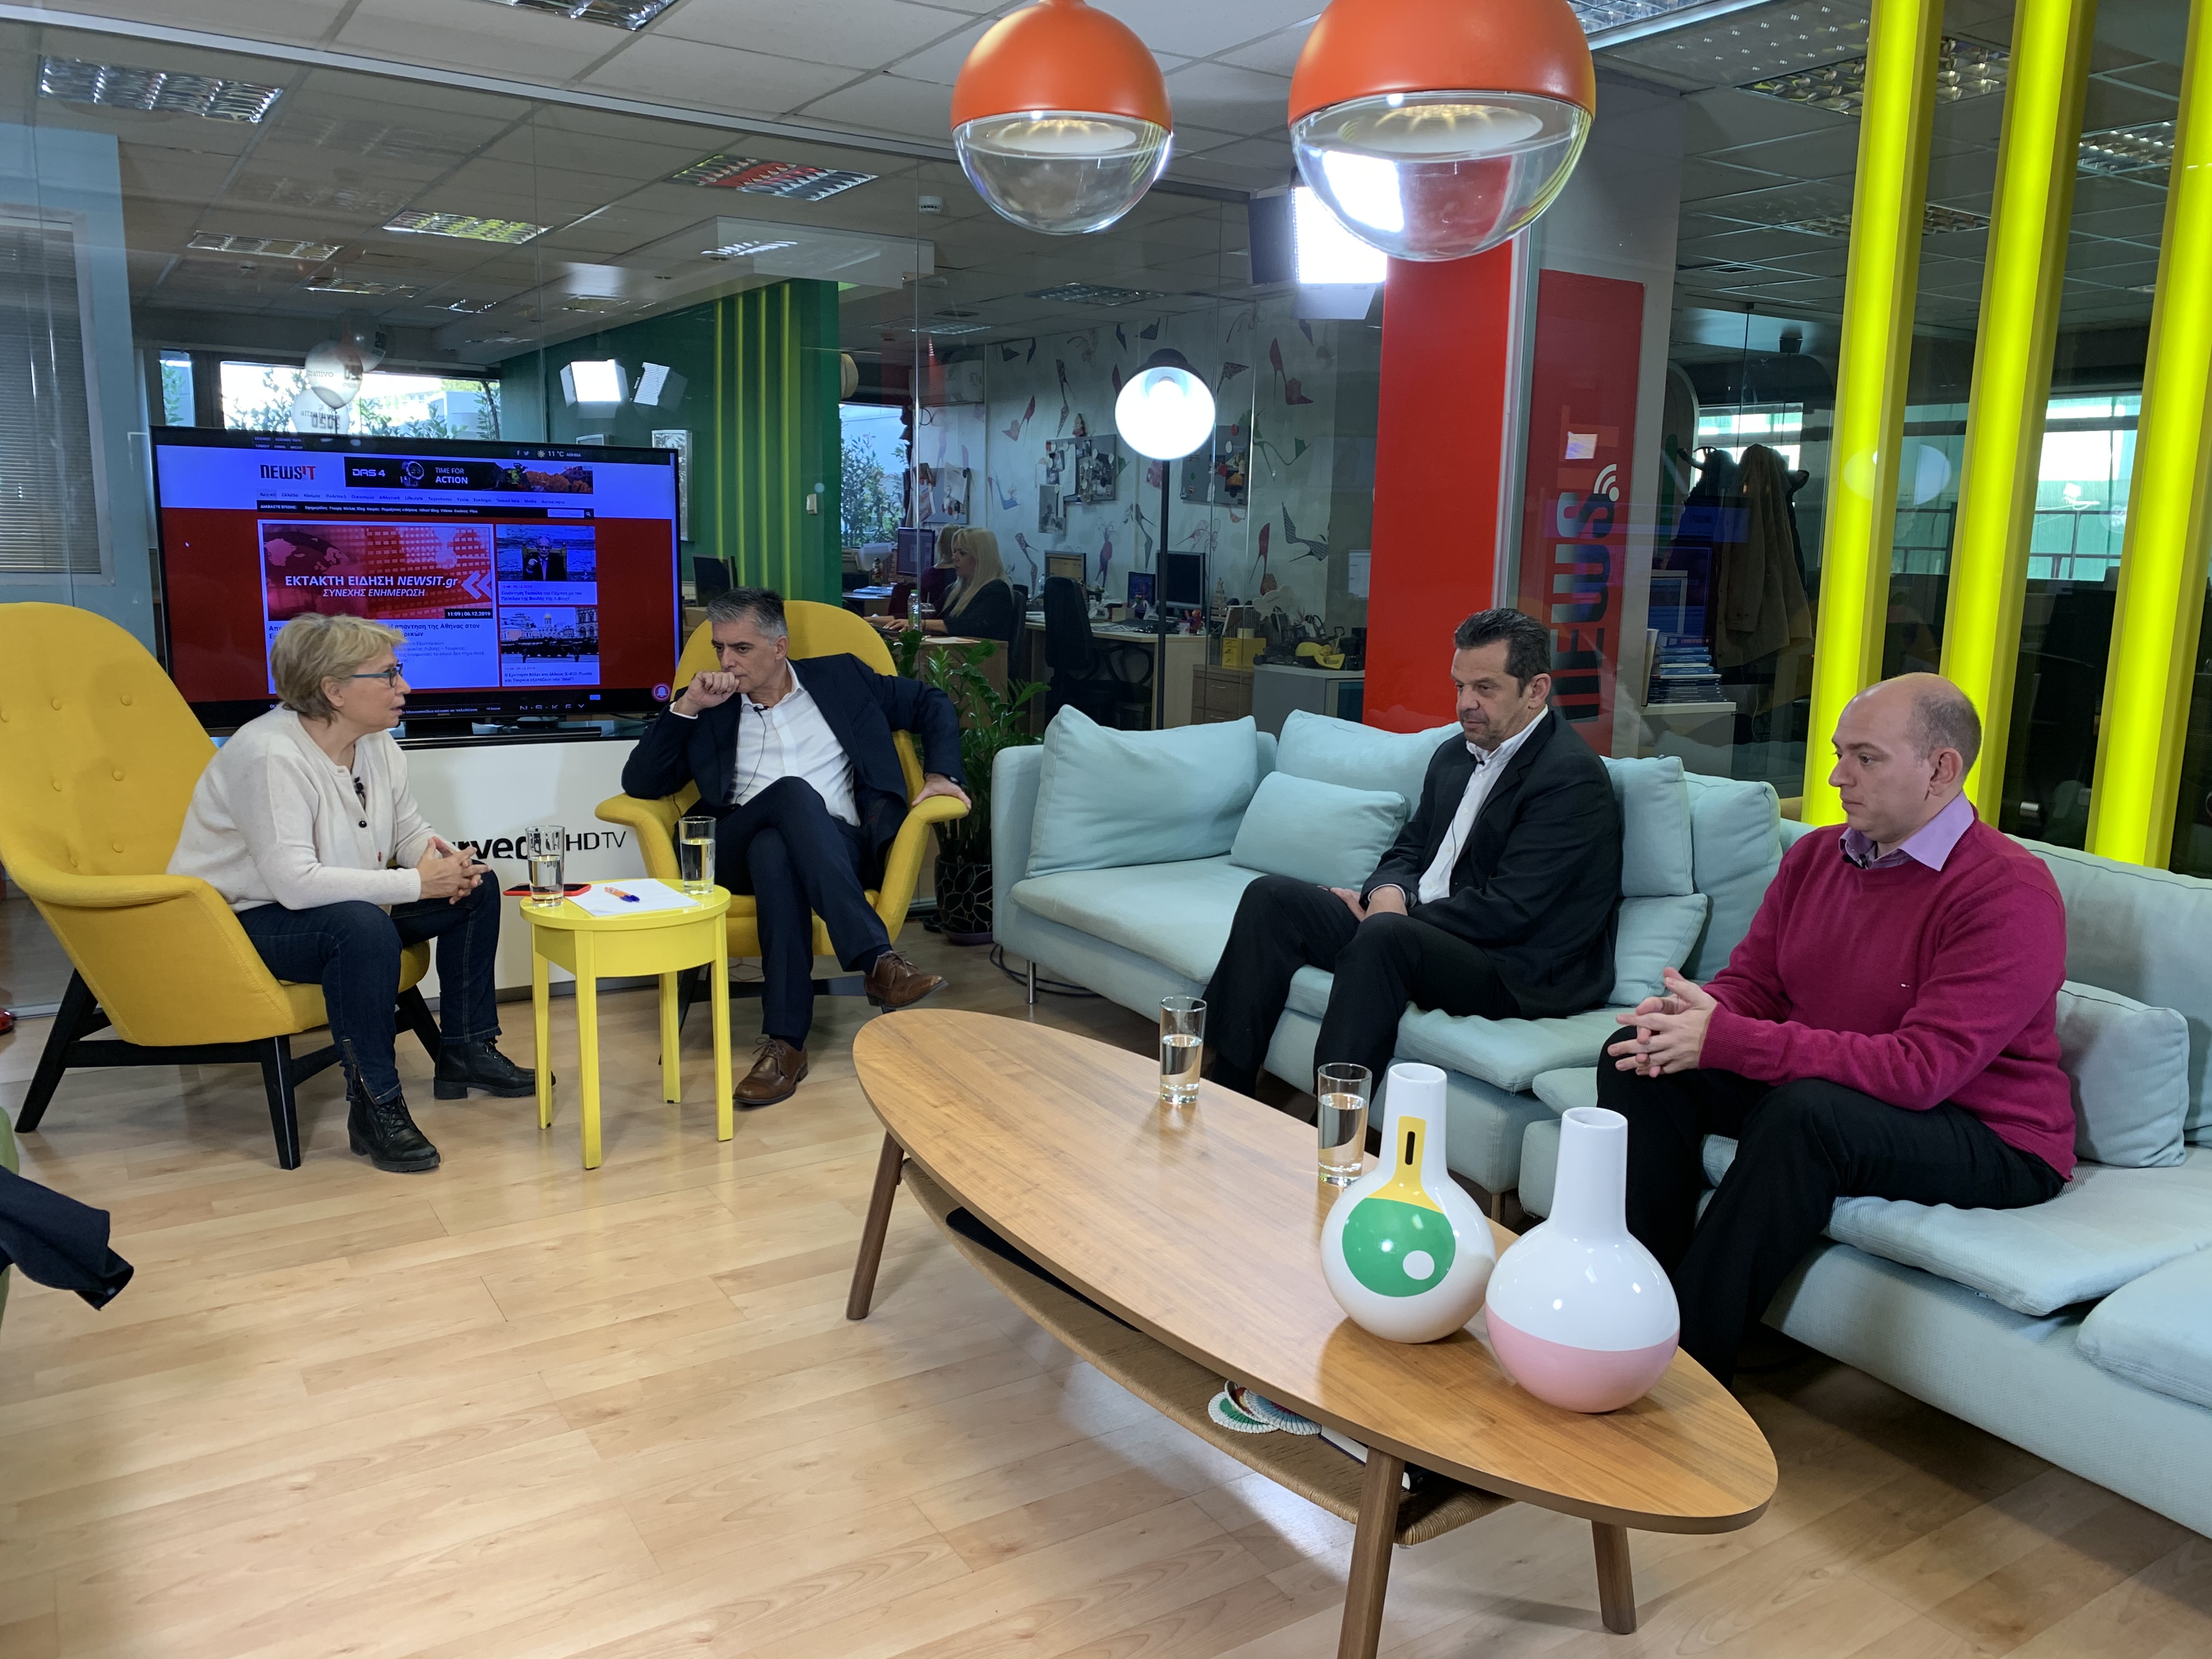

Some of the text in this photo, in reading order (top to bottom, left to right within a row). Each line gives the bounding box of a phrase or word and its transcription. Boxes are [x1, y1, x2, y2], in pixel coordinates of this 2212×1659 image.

[435, 476, 468, 484] ACTION
[285, 575, 458, 589] ΕΚΤΑΚΤΗ ΕΙΔΗΣΗ NEWSIT.gr
[323, 589, 426, 597] ΣΥΝΕΧΗΣ ΕΝΗΜΕΡΩΣΗ
